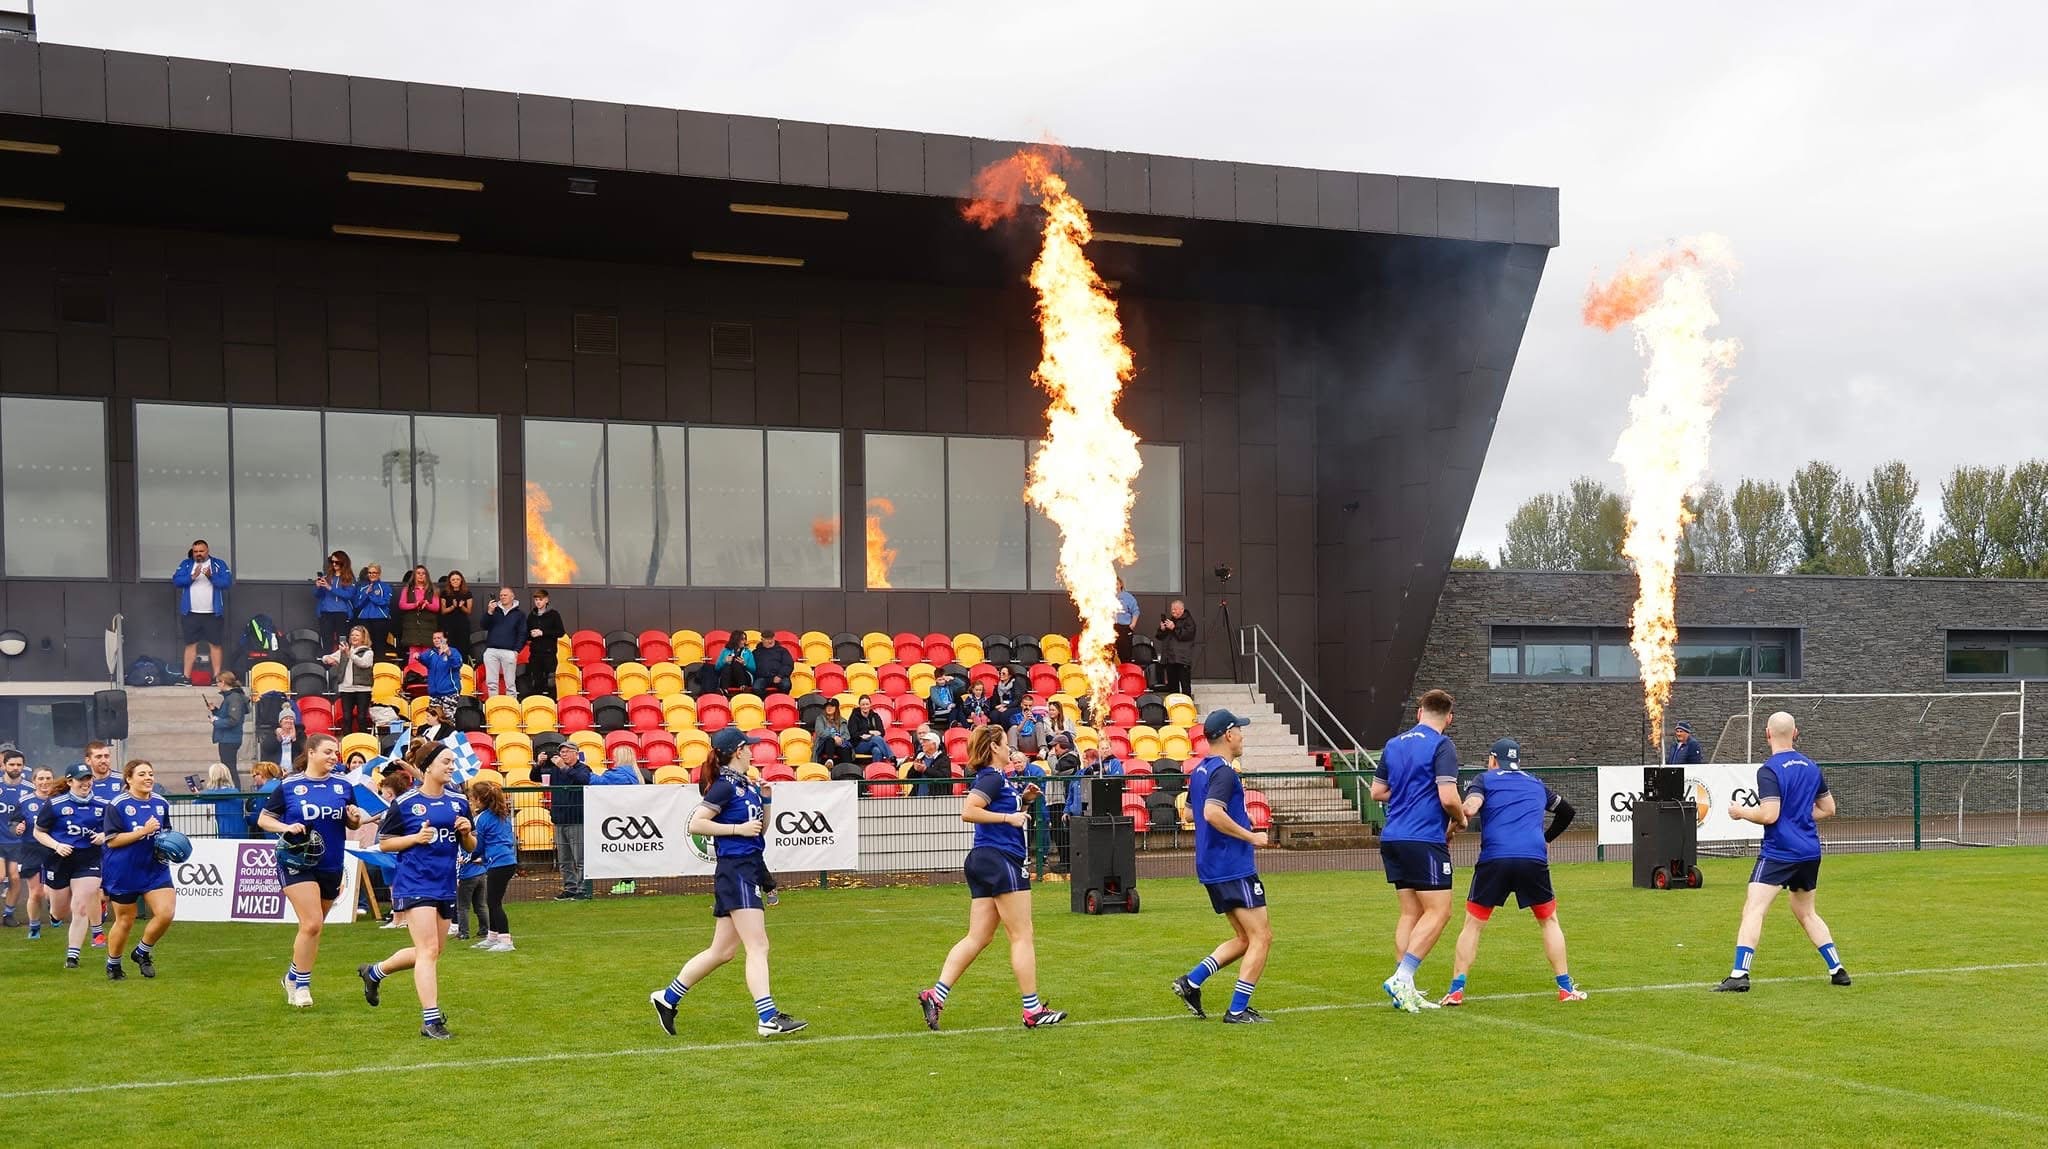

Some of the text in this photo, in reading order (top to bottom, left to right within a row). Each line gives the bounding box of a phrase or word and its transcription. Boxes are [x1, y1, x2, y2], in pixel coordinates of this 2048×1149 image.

[602, 816, 663, 841] GAA
[775, 811, 834, 835] GAA
[601, 841, 665, 853] ROUNDERS
[775, 836, 835, 847] ROUNDERS
[177, 863, 224, 886] GAA
[240, 867, 278, 876] ROUNDER
[175, 886, 224, 897] ROUNDERS
[236, 895, 280, 915] MIXED
